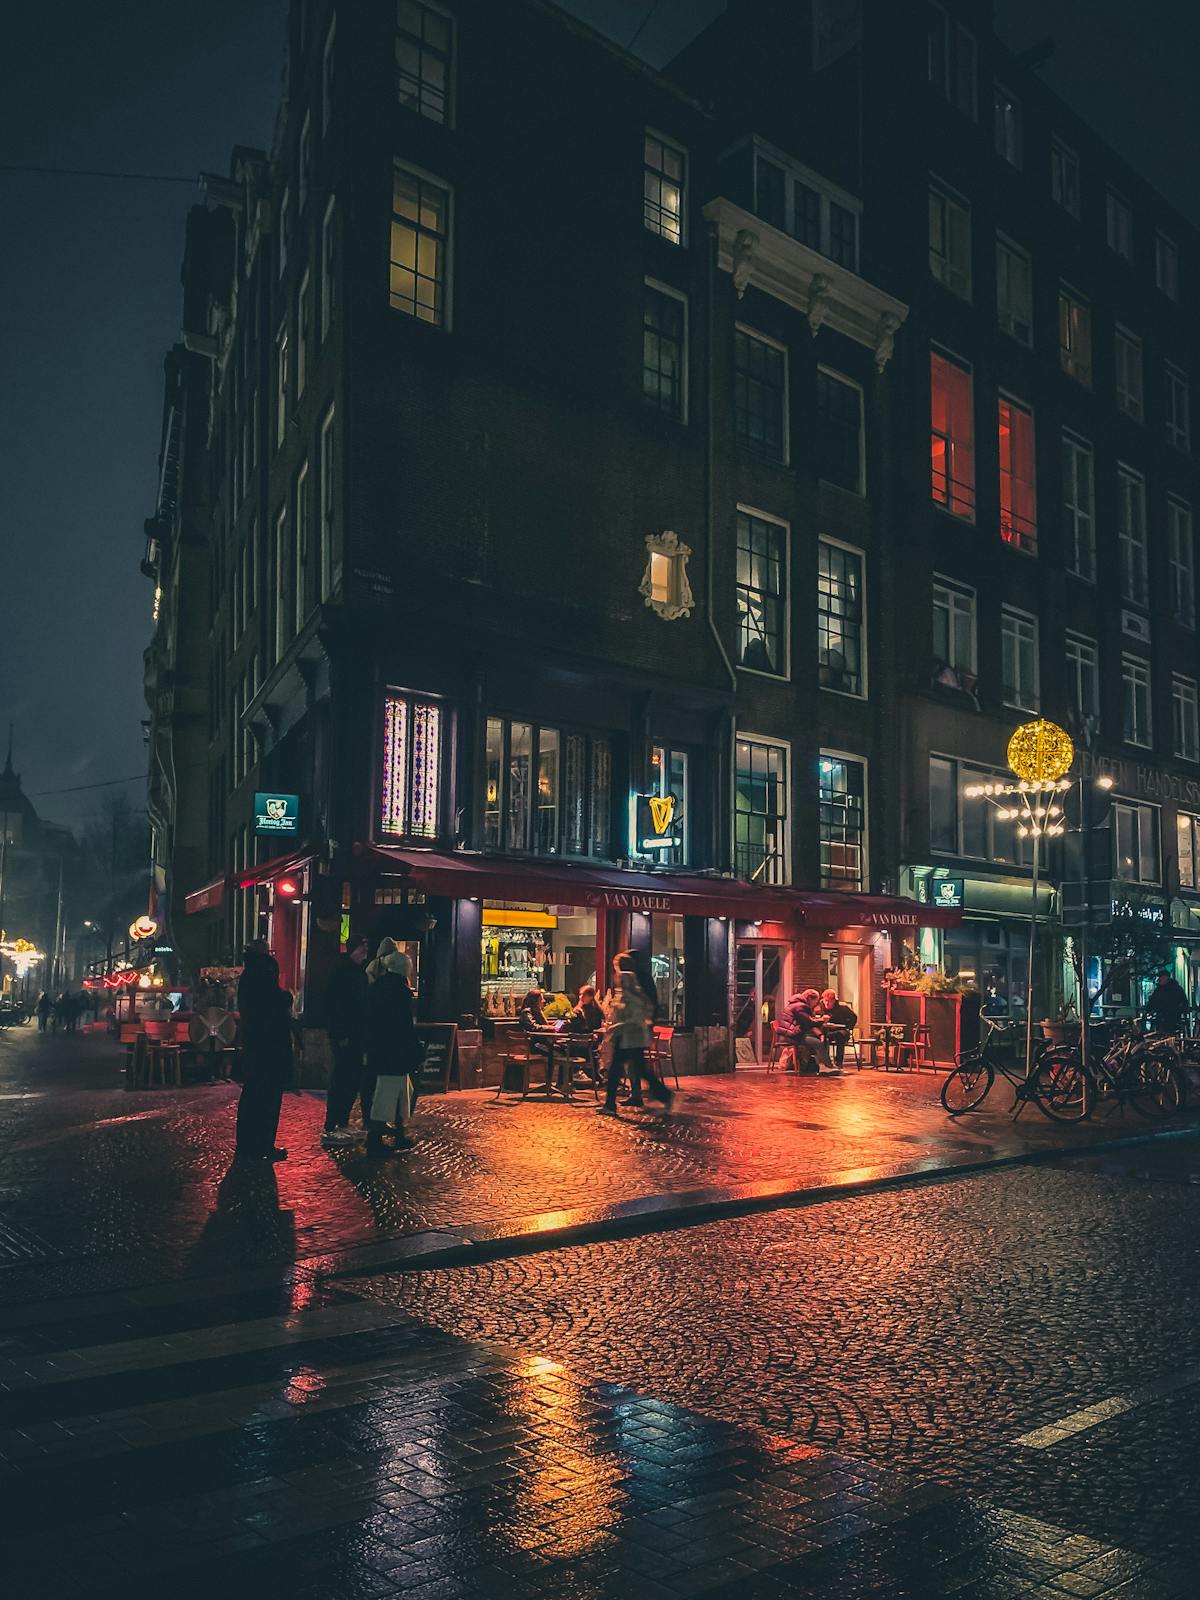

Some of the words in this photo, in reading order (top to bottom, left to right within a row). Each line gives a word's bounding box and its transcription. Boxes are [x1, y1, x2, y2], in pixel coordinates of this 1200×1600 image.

[604, 893, 629, 908] VAN
[631, 895, 671, 911] DAELE
[872, 913, 889, 925] VAN
[890, 914, 918, 925] DAELE
